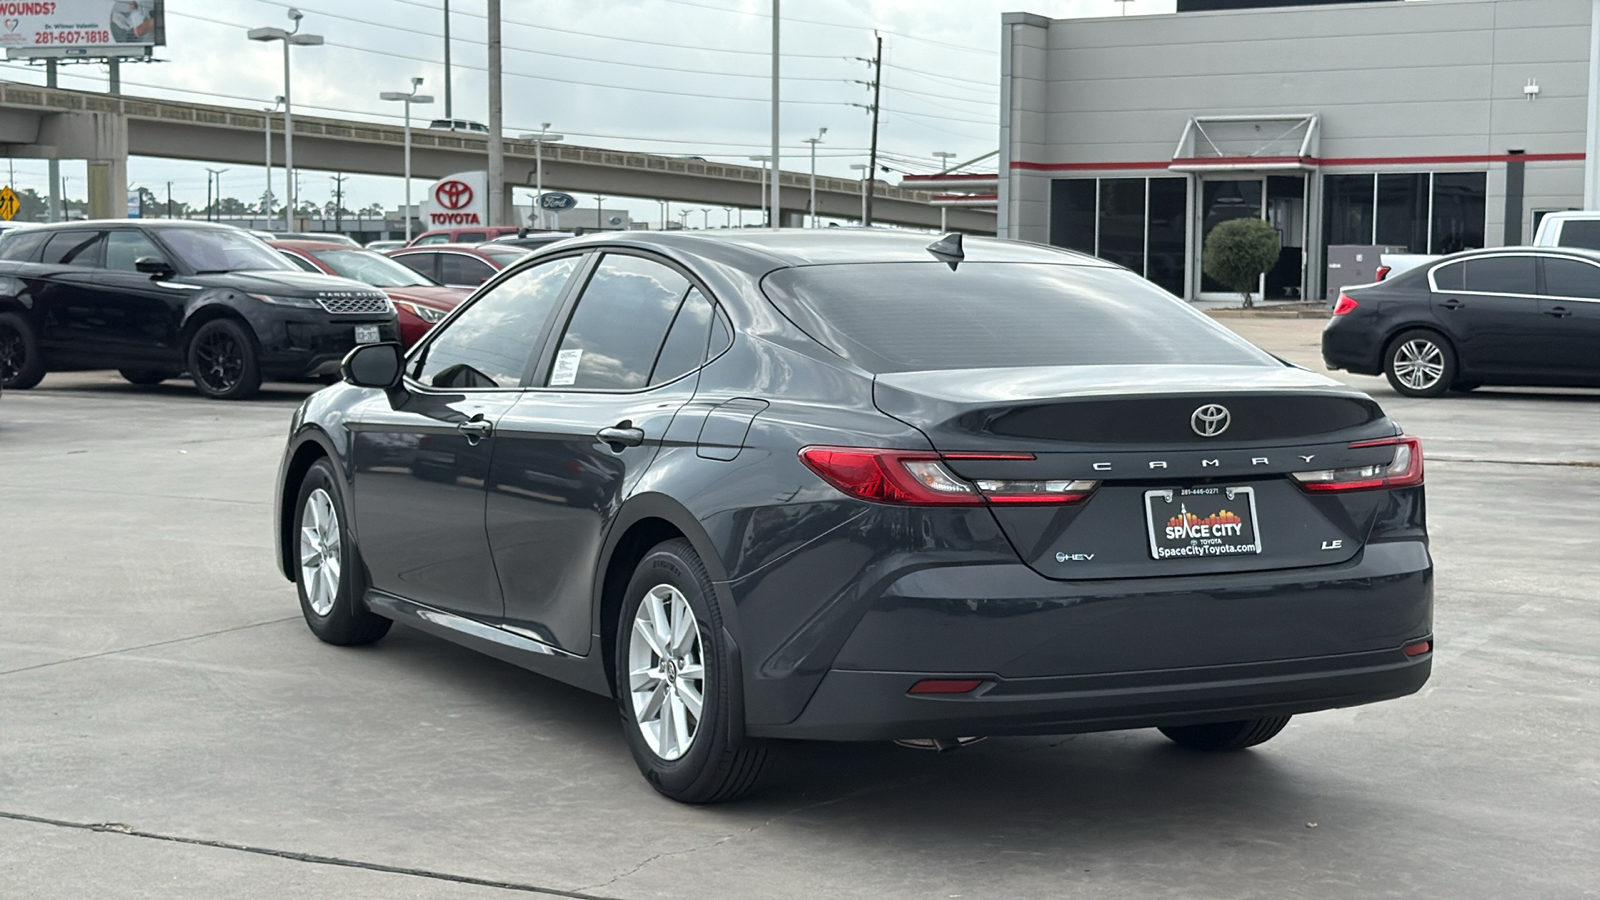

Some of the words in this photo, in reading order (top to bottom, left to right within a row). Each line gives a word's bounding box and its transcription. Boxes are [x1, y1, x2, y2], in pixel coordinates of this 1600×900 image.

[35, 31, 109, 44] 281-607-1818
[543, 195, 567, 208] Ford
[430, 213, 481, 226] TOYOTA
[1093, 455, 1315, 471] CAMRY
[1165, 524, 1210, 539] SPACE
[1212, 523, 1242, 537] CITY
[1158, 543, 1256, 557] SpaceCityToyota.com
[1321, 540, 1343, 550] LE
